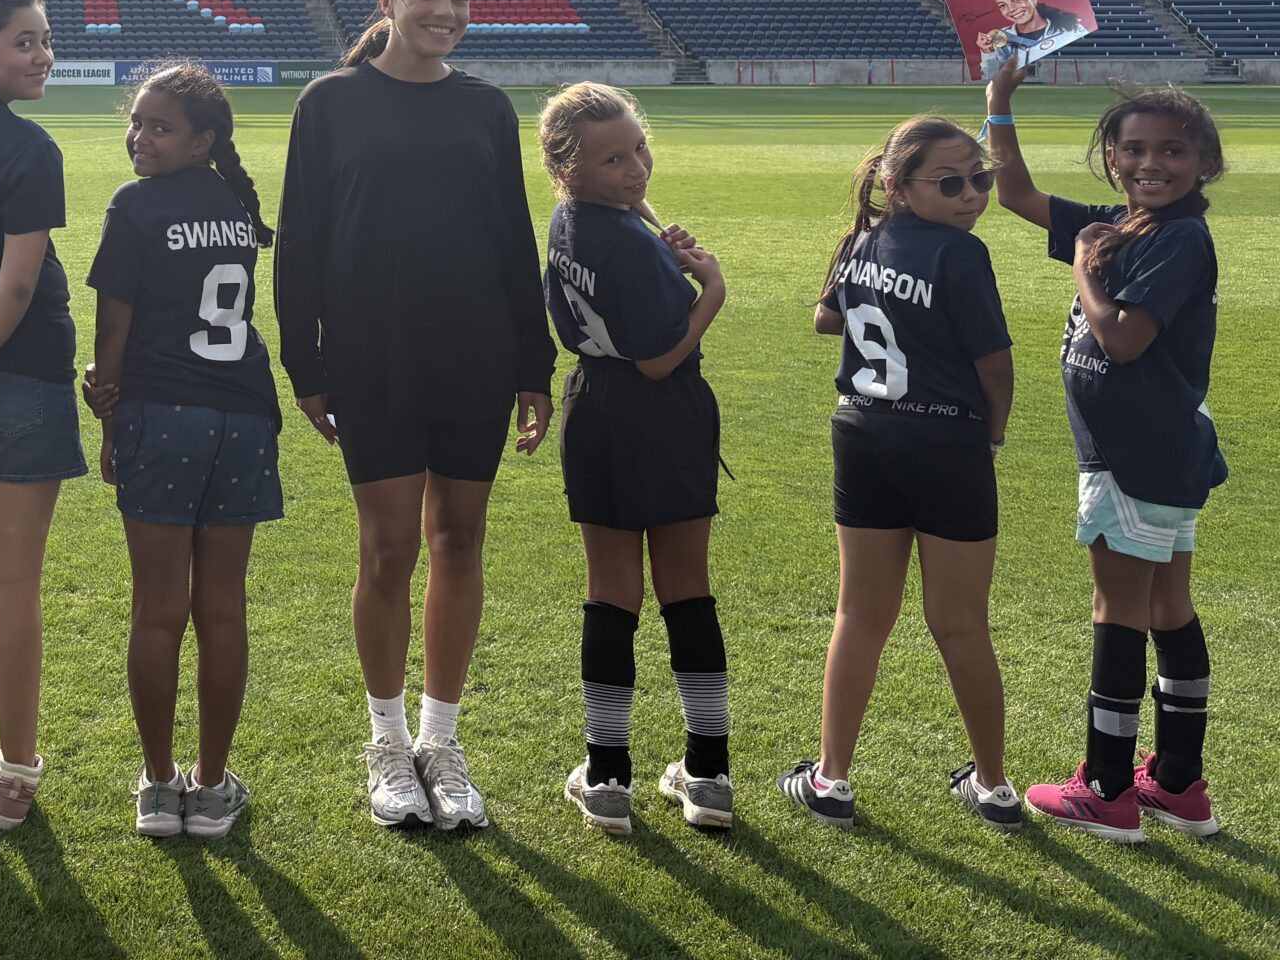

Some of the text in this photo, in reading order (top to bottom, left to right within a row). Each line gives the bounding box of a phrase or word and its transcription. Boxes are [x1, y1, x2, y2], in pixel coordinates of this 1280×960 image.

[50, 69, 111, 78] SOCCER LEAGUE
[280, 70, 310, 79] WITHOUT
[166, 220, 258, 251] SWANSO
[189, 263, 249, 361] 9
[846, 303, 908, 401] 9
[891, 400, 926, 413] NIKE
[928, 403, 958, 416] PRO
